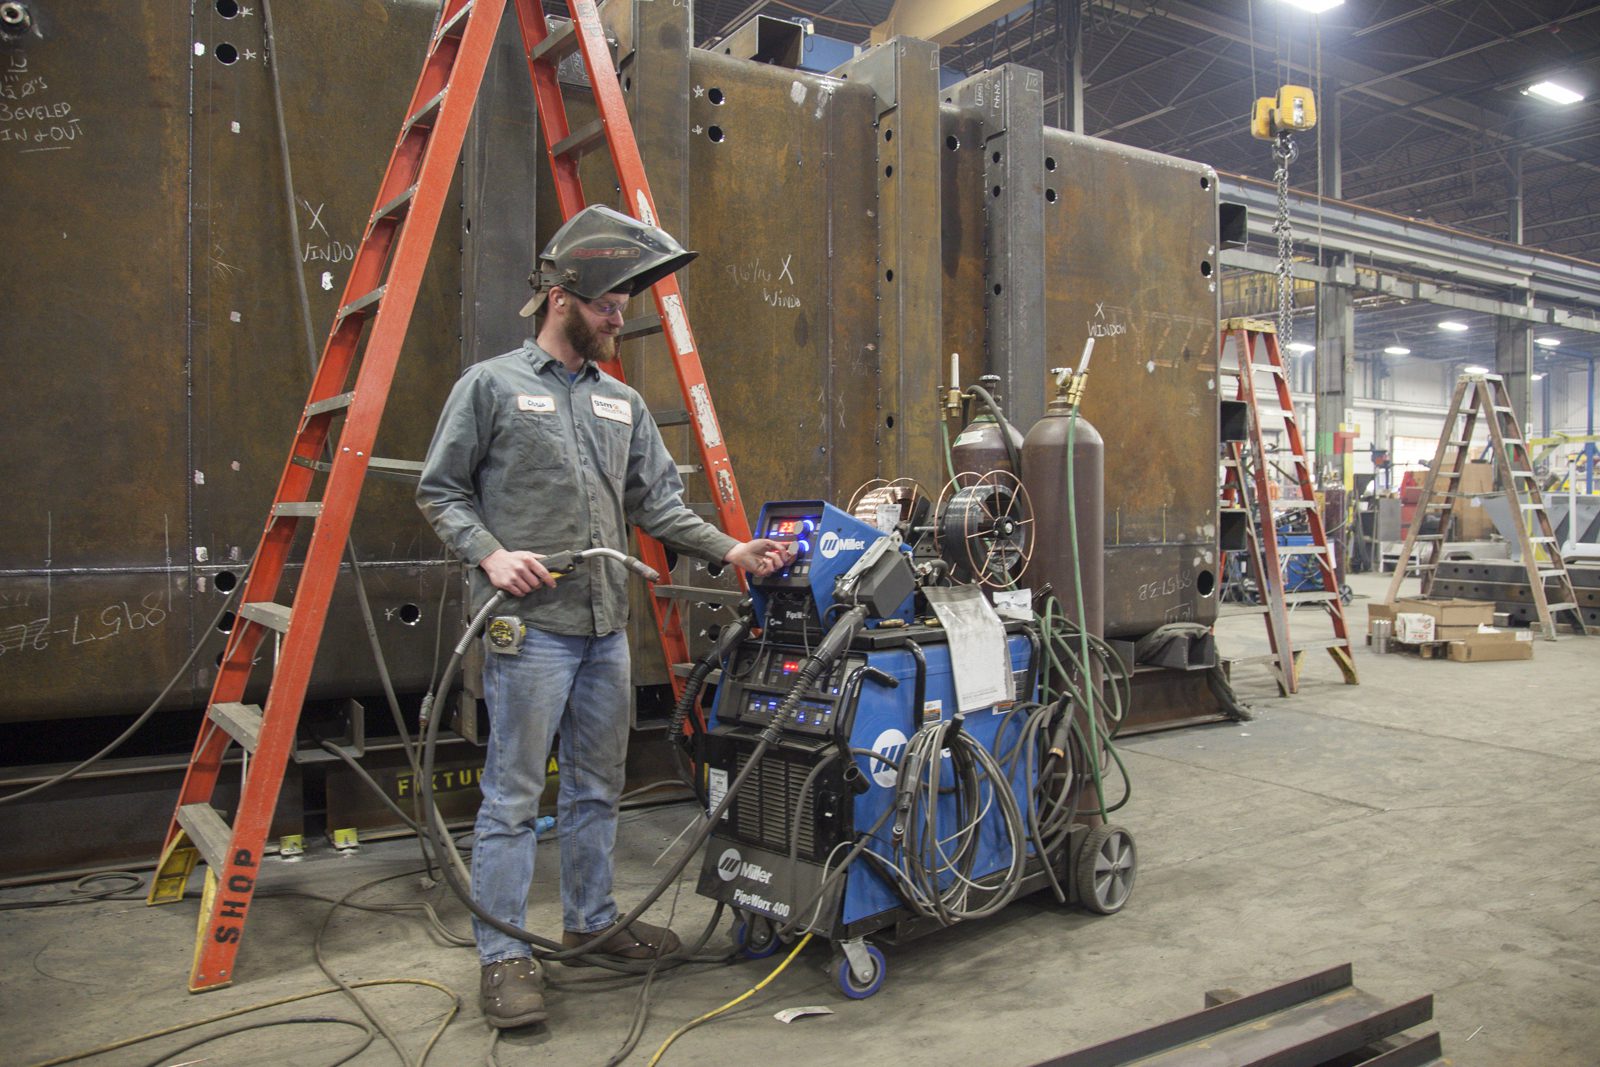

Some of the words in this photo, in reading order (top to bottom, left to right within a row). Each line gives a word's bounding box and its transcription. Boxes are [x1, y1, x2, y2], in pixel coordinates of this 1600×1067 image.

[0, 128, 28, 142] IN
[50, 118, 84, 142] OUT
[839, 538, 866, 552] Miller
[740, 861, 773, 884] Miller
[214, 848, 257, 945] SHOP
[733, 888, 774, 912] PipeWorx
[772, 901, 791, 918] 400
